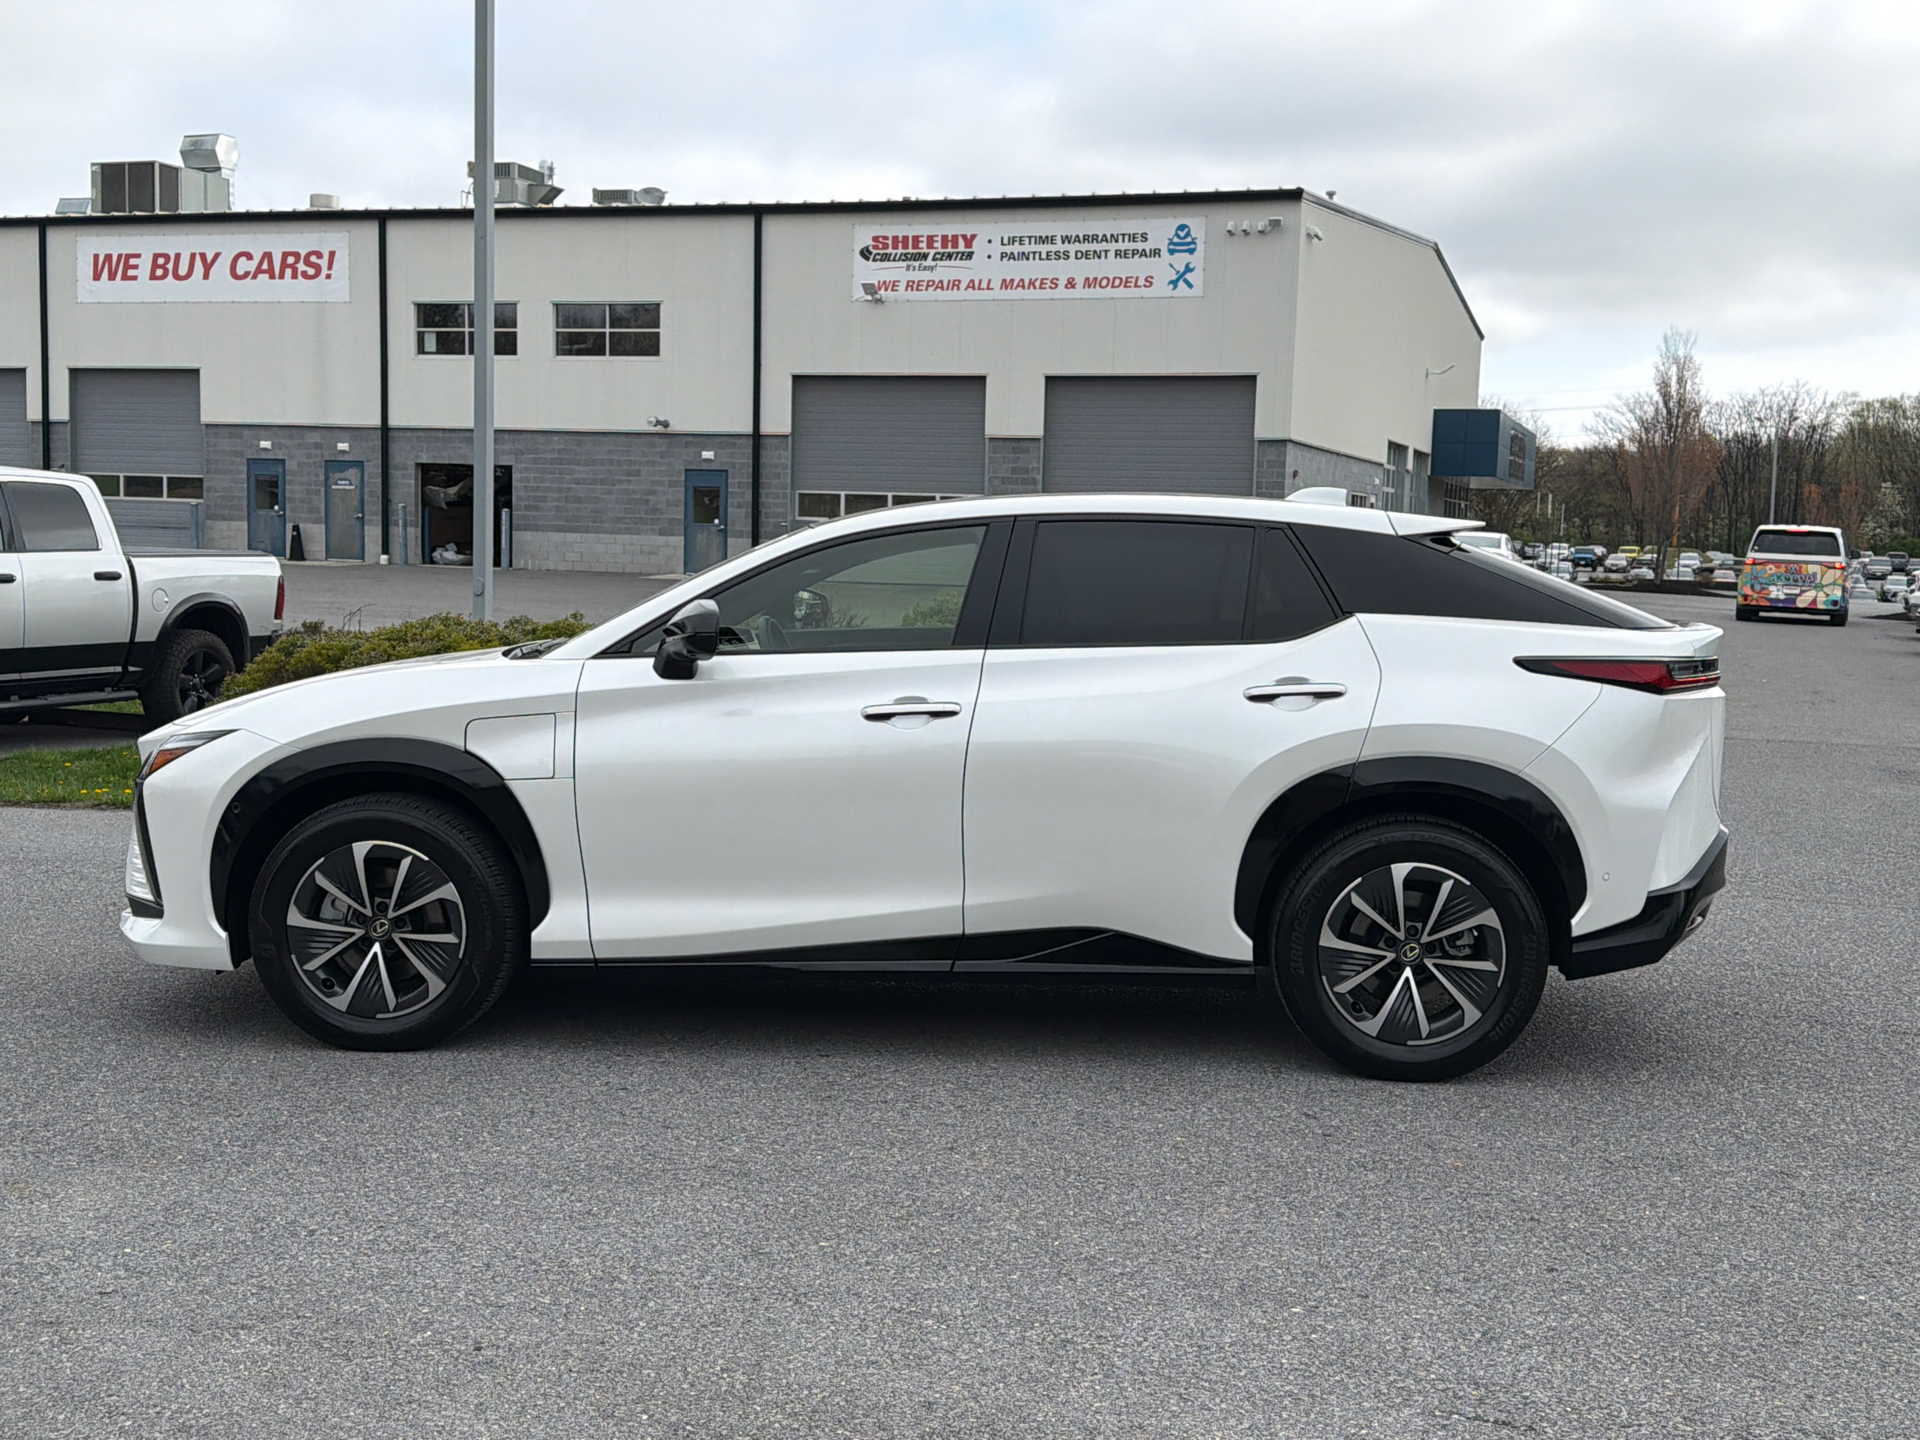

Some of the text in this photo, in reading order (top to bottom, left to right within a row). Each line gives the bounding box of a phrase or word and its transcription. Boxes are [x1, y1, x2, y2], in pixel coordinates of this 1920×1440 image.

[871, 233, 979, 251] SHEEHY
[1000, 232, 1149, 246] LIFETIME WARRANTIES
[871, 250, 976, 263] COLLISION CENTER
[1000, 248, 1162, 262] PAINTLESS DENT REPAIR
[92, 250, 337, 281] WE BUY CARS!
[905, 262, 938, 273] It's Easy!
[877, 275, 1155, 292] WE REPAIR ALL MAKES & MODELS
